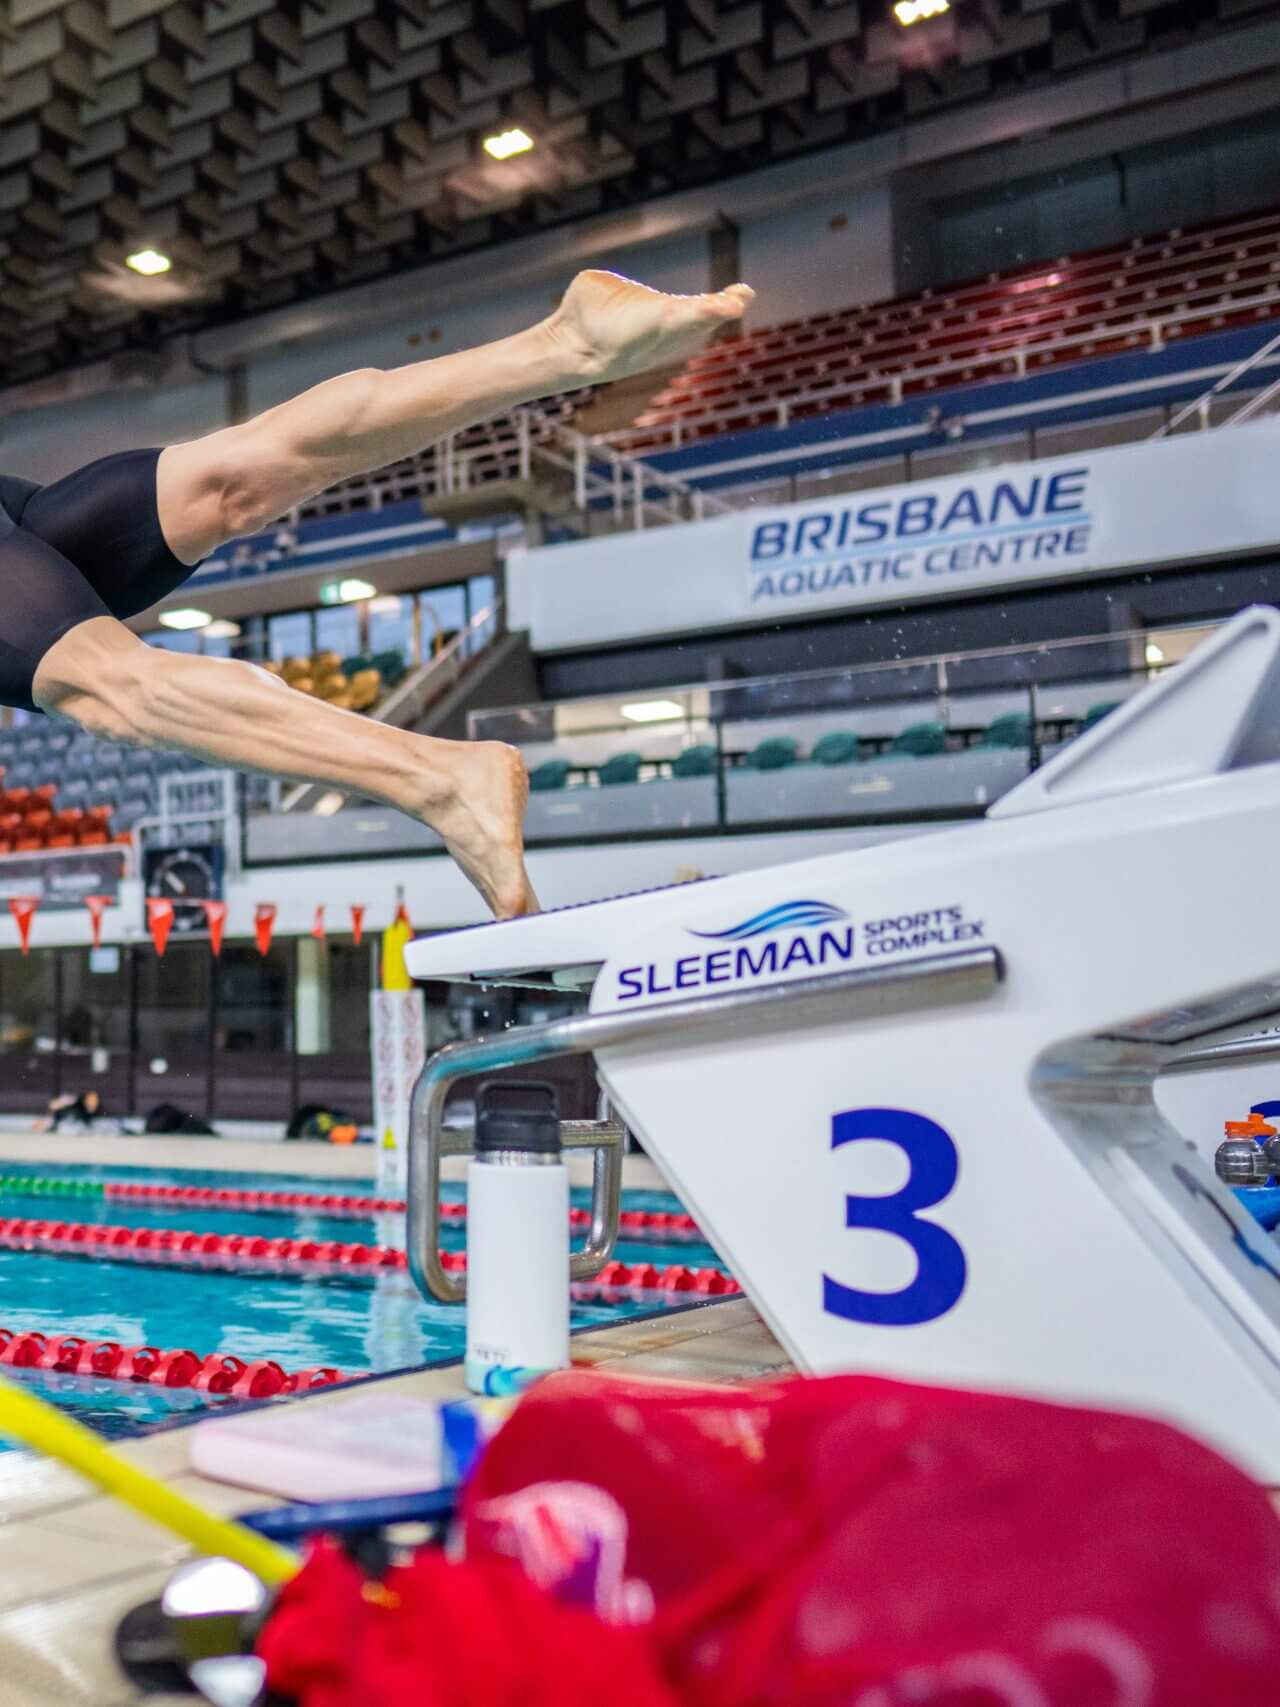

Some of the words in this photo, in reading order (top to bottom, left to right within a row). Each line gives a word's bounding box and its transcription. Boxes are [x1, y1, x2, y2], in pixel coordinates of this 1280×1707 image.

[750, 467, 1089, 560] BRISBANE
[751, 553, 916, 602] AQUATIC
[923, 524, 1091, 577] CENTRE
[863, 905, 963, 938] SPORTS
[865, 921, 985, 956] COMPLEX
[618, 927, 853, 1000] SLEEMAN
[821, 1107, 967, 1326] 3
